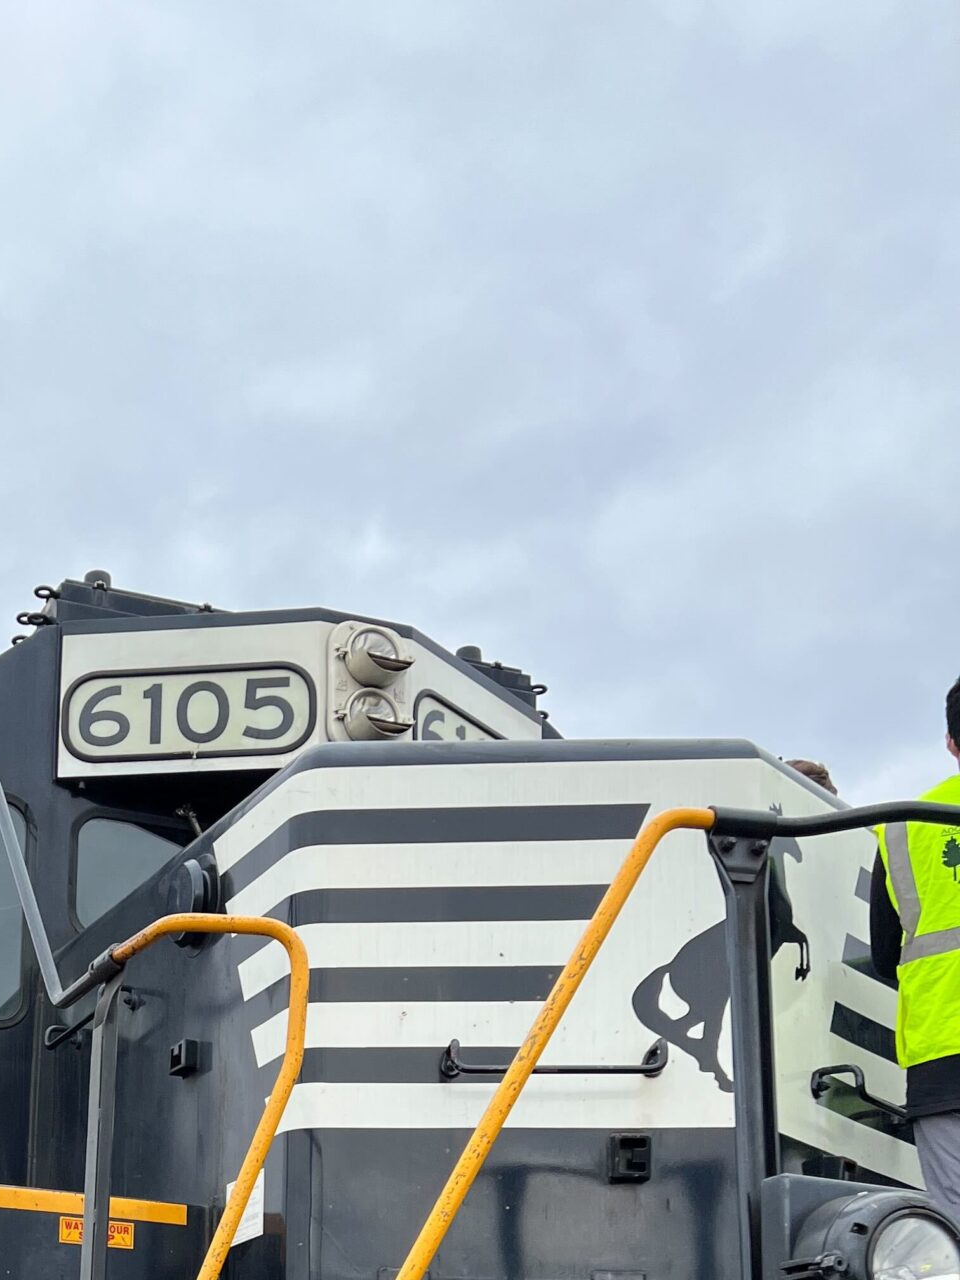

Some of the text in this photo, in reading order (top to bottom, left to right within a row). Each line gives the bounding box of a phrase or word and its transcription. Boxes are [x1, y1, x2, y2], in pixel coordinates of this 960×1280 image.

[78, 676, 295, 747] 6105
[64, 1221, 130, 1235] WAT OUR
